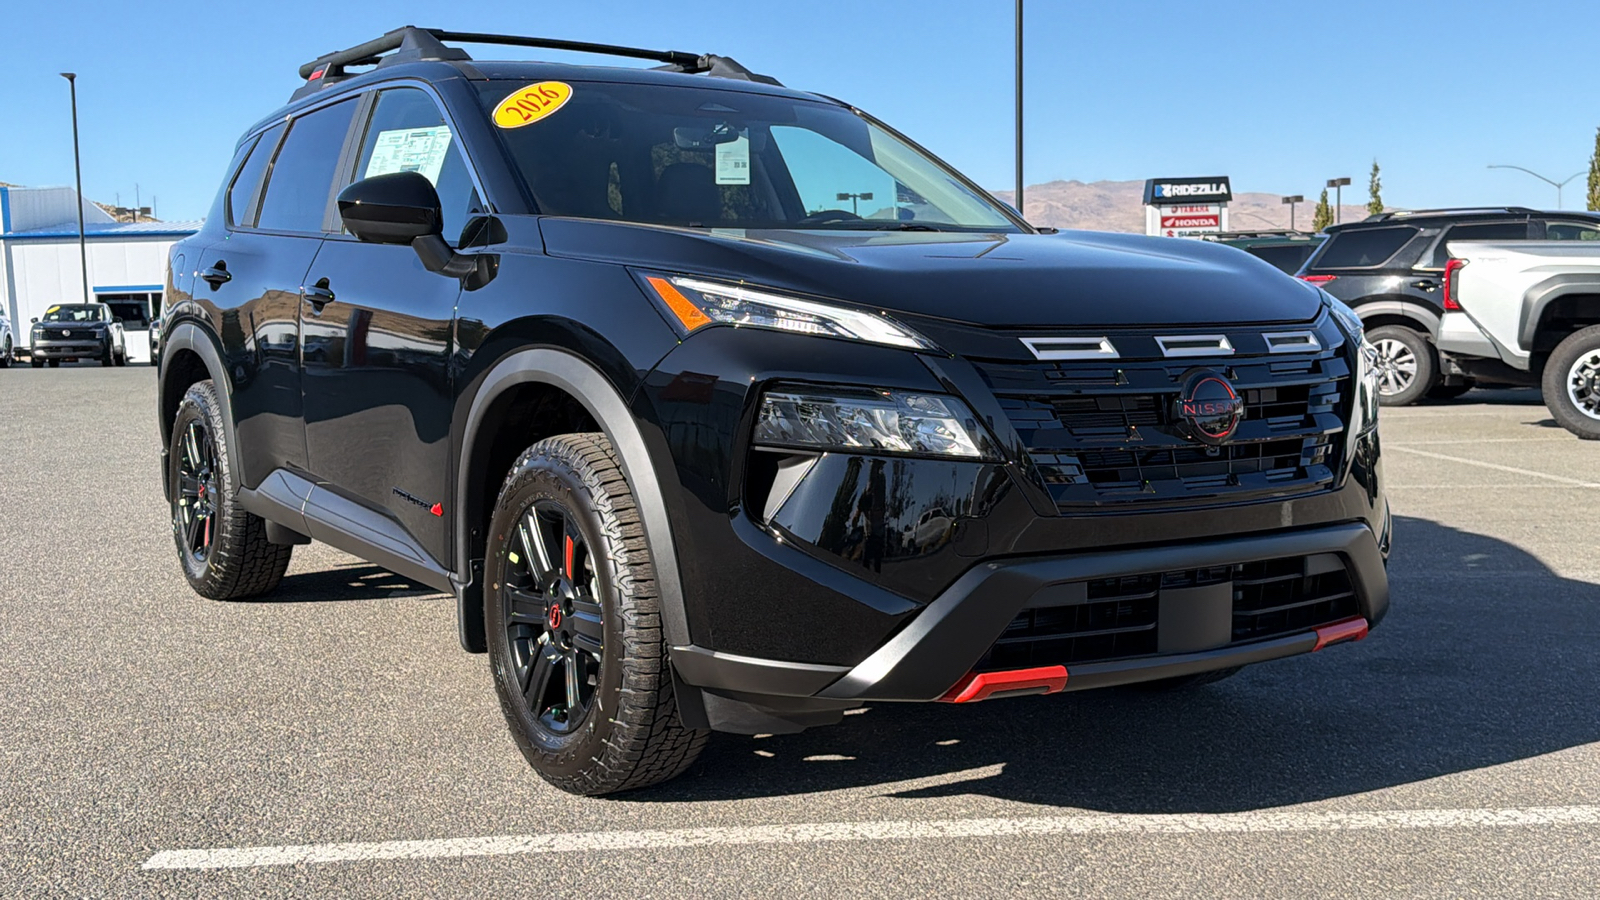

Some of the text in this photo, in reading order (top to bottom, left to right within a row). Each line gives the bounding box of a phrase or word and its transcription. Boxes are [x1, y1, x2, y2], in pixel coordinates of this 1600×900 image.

[505, 85, 560, 121] 2026
[1172, 183, 1228, 196] RIDEZILLA
[1179, 205, 1209, 213] YAMAHA
[1175, 218, 1217, 227] HONDA
